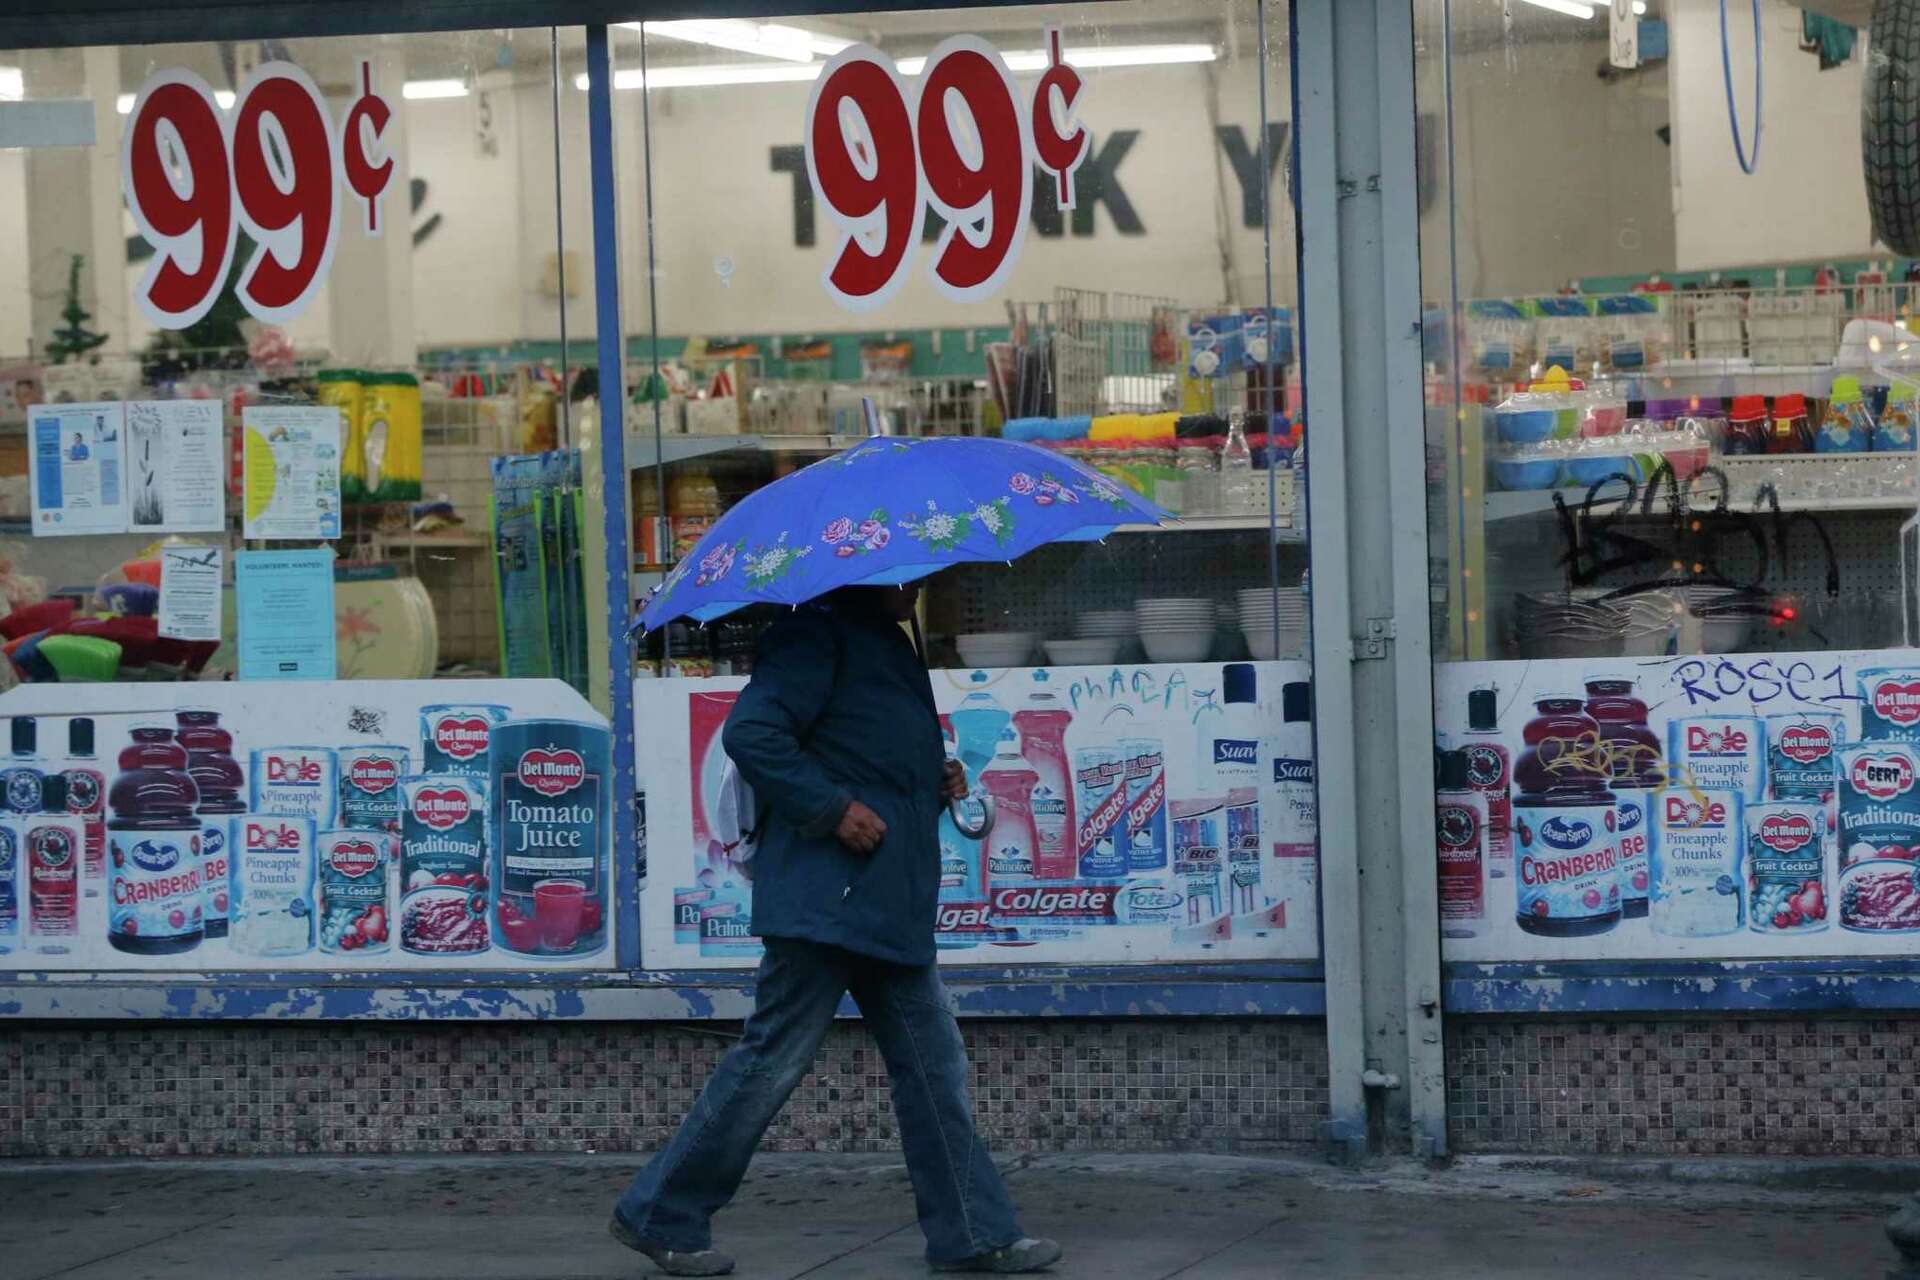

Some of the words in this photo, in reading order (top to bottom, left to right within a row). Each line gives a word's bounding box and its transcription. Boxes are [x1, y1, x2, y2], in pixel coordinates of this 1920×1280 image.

[812, 30, 1086, 297] 99¢
[130, 60, 395, 315] 99¢
[1877, 693, 1894, 705] Del
[438, 730, 454, 741] Del
[1687, 726, 1748, 752] Dole
[1783, 737, 1799, 747] Del
[1799, 737, 1829, 747] Monte
[267, 756, 321, 782] Dole
[353, 769, 367, 778] Del
[368, 769, 395, 778] Monte
[523, 761, 541, 776] Del
[543, 762, 581, 777] Monte
[1688, 760, 1749, 777] Pineapple
[266, 790, 322, 807] Pineapple
[416, 800, 432, 811] Del
[434, 800, 467, 811] Monte
[507, 800, 594, 824] Tomato
[1079, 792, 1125, 846] Colgate
[1666, 797, 1726, 825] Dole
[247, 824, 300, 850] Dole
[516, 824, 583, 851] Juice
[1542, 825, 1568, 841] Ocean
[1567, 828, 1591, 842] Spray
[1763, 826, 1778, 836] Del
[1779, 826, 1809, 836] Monte
[403, 834, 481, 858] Traditional
[1666, 832, 1728, 848] Pineapple
[333, 853, 347, 862] Del
[347, 853, 375, 862] Monte
[1671, 848, 1722, 860] Chunks
[246, 857, 301, 871] Pineapple
[989, 859, 1033, 873] Palmolive
[1756, 861, 1777, 871] Fruit
[1780, 861, 1818, 871] Cocktail
[250, 871, 296, 884] Chunks
[1574, 880, 1598, 890] DRINK
[325, 886, 345, 895] Fruit
[349, 886, 382, 895] Cocktail
[996, 888, 1106, 915] Colgate
